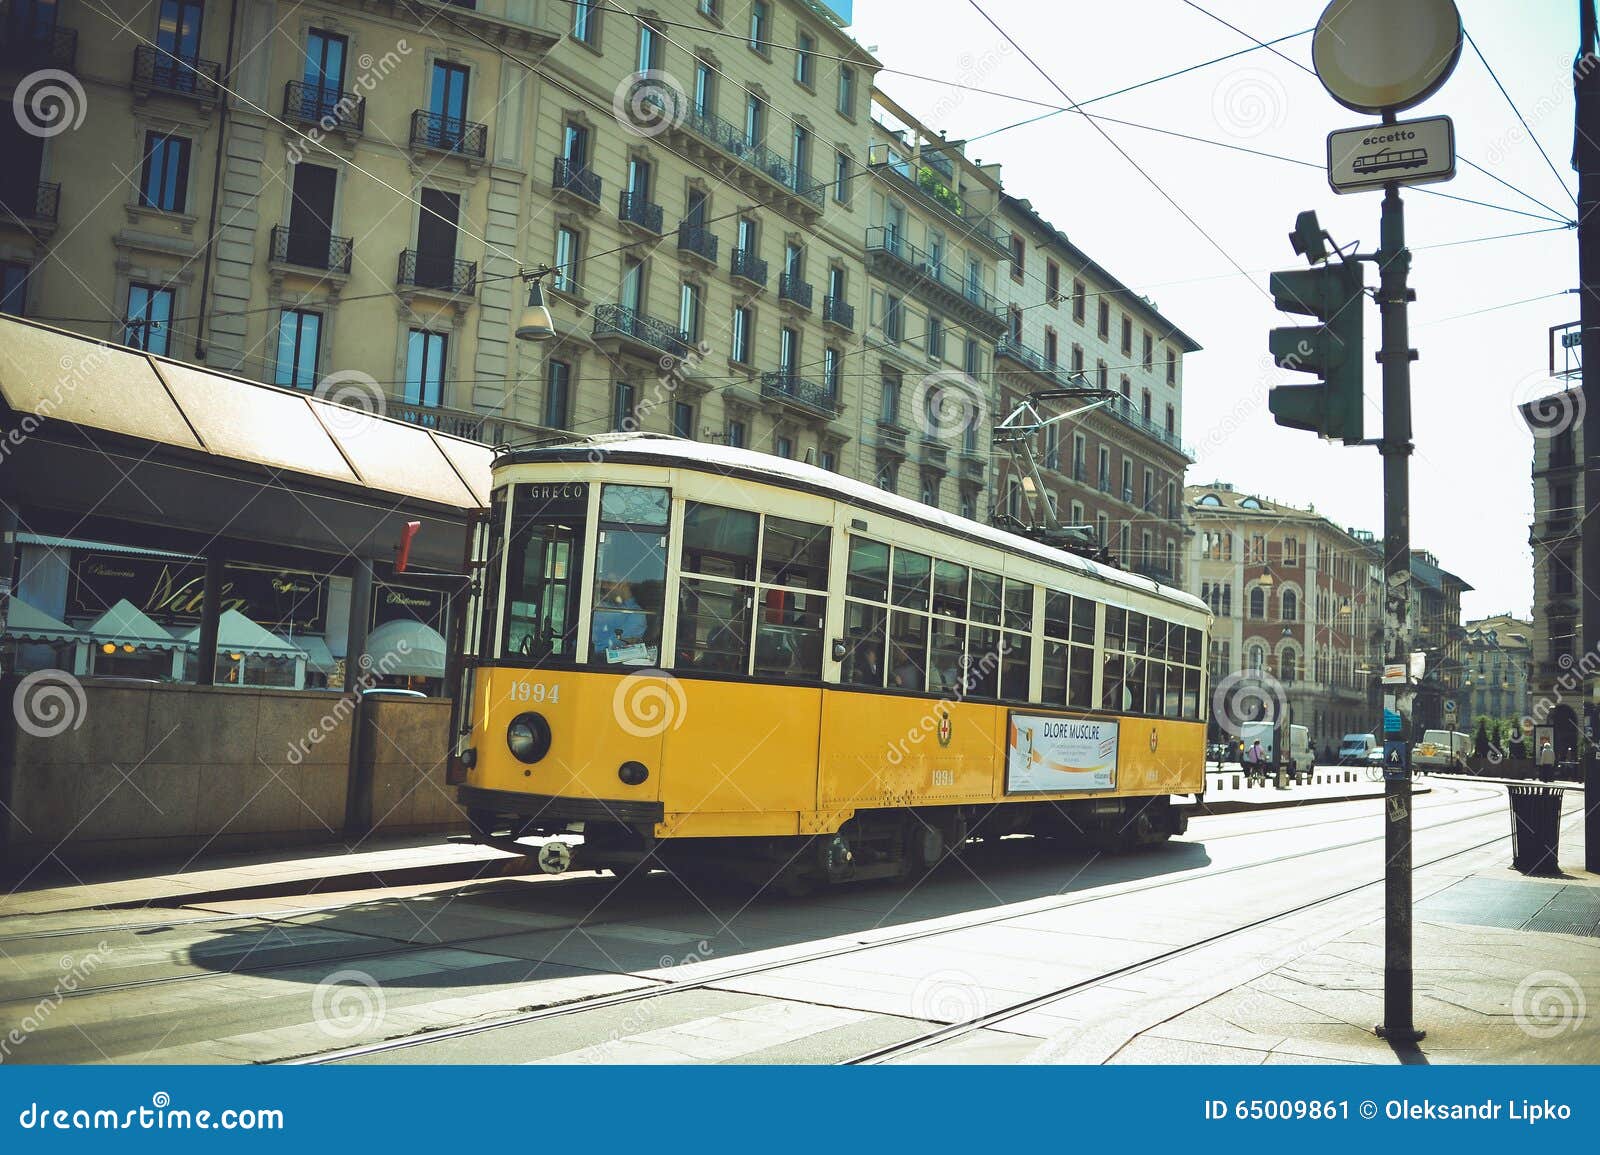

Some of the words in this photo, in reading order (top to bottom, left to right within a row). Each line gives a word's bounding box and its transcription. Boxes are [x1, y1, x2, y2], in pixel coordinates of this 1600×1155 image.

[1363, 130, 1415, 145] eccetto
[531, 485, 582, 499] GRECO
[510, 680, 560, 704] 1994
